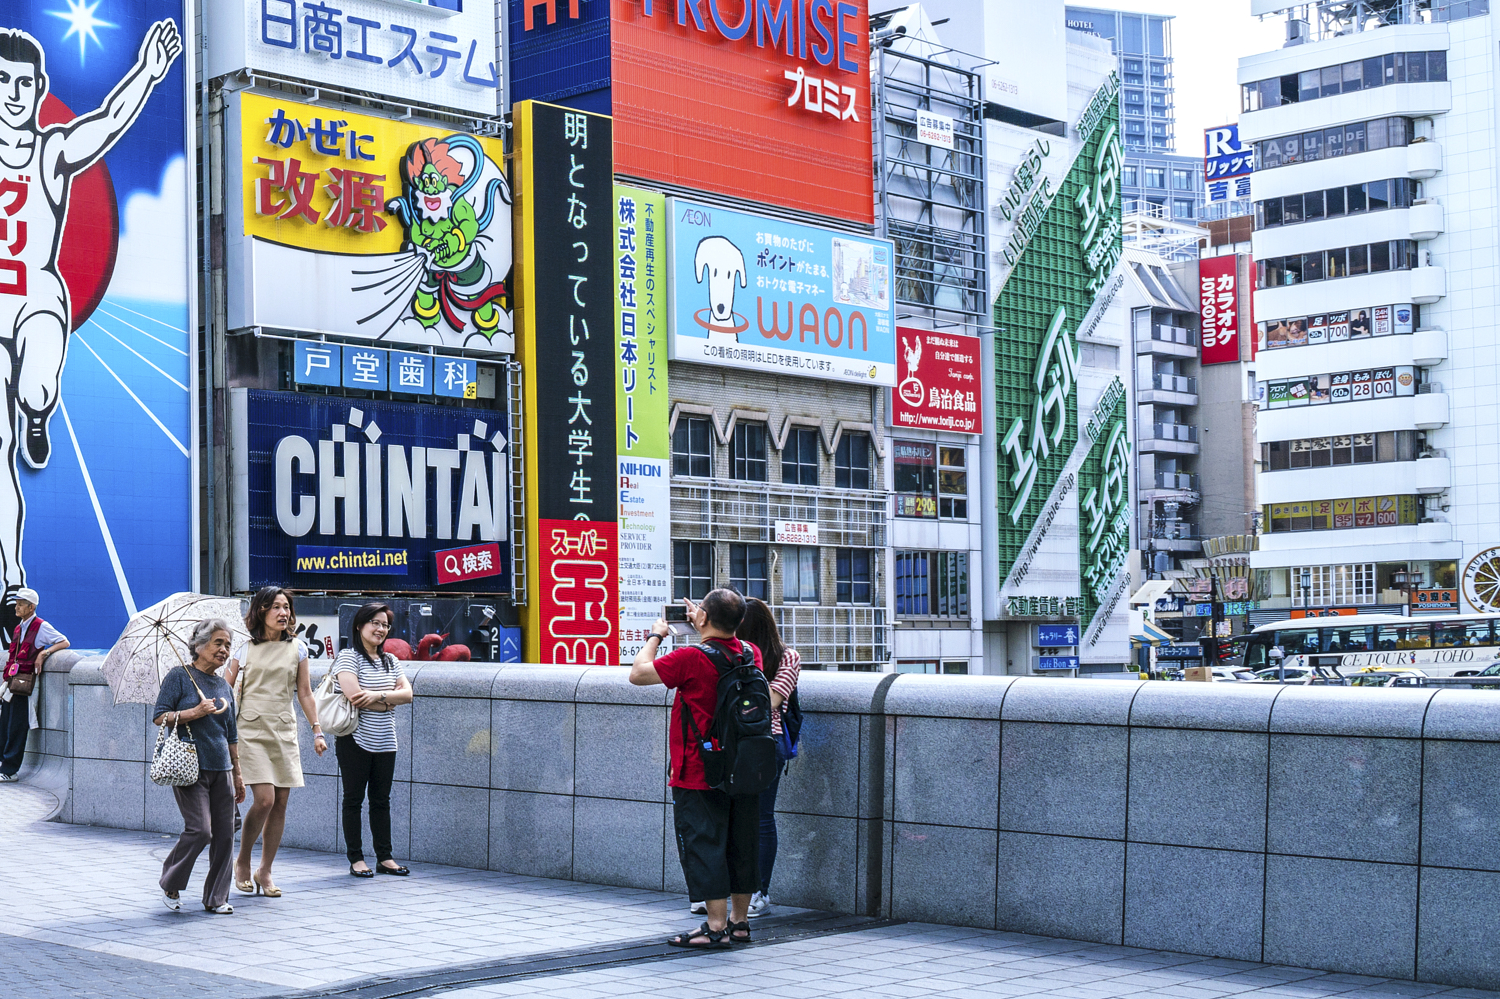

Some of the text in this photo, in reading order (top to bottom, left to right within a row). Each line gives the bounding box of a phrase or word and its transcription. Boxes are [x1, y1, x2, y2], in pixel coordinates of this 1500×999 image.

[1067, 19, 1093, 29] HOTEL
[784, 66, 860, 122] プロミス
[264, 108, 376, 162] かぜに
[252, 156, 388, 233] 改源
[998, 138, 1051, 223] いい暮らし
[1002, 175, 1055, 267] いい部屋で
[756, 231, 815, 254] お買物のたびに
[645, 203, 657, 395] 不動産再生のスペシャリスト
[756, 275, 825, 297] おトクな電子マネー
[1086, 274, 1124, 337] www.able.co.jp
[1202, 276, 1216, 348] JOYSOUND
[1216, 274, 1237, 346] カラオケ
[619, 196, 640, 451] 株式会社日本リート
[756, 296, 868, 352] WAON
[304, 347, 469, 392] 戸堂歯科
[703, 344, 836, 373] この看板の照明はLEDを使用しています。
[928, 387, 976, 412] 鳥治食品
[620, 462, 661, 478] NIHON
[620, 477, 639, 489] Real
[620, 491, 644, 503] Estate
[620, 504, 655, 518] Investment
[620, 517, 656, 532] Technology
[620, 533, 647, 541] SERVICE
[1014, 471, 1076, 587] http://www.able.co.jp
[551, 529, 608, 557] スーパー
[620, 541, 652, 551] PROVIDER
[462, 550, 493, 574] 検索
[1465, 549, 1497, 579] FRUITS
[1006, 596, 1085, 616] 不動産賃貸・管理
[1366, 652, 1407, 666] TOUR
[1432, 649, 1474, 663] TOHO
